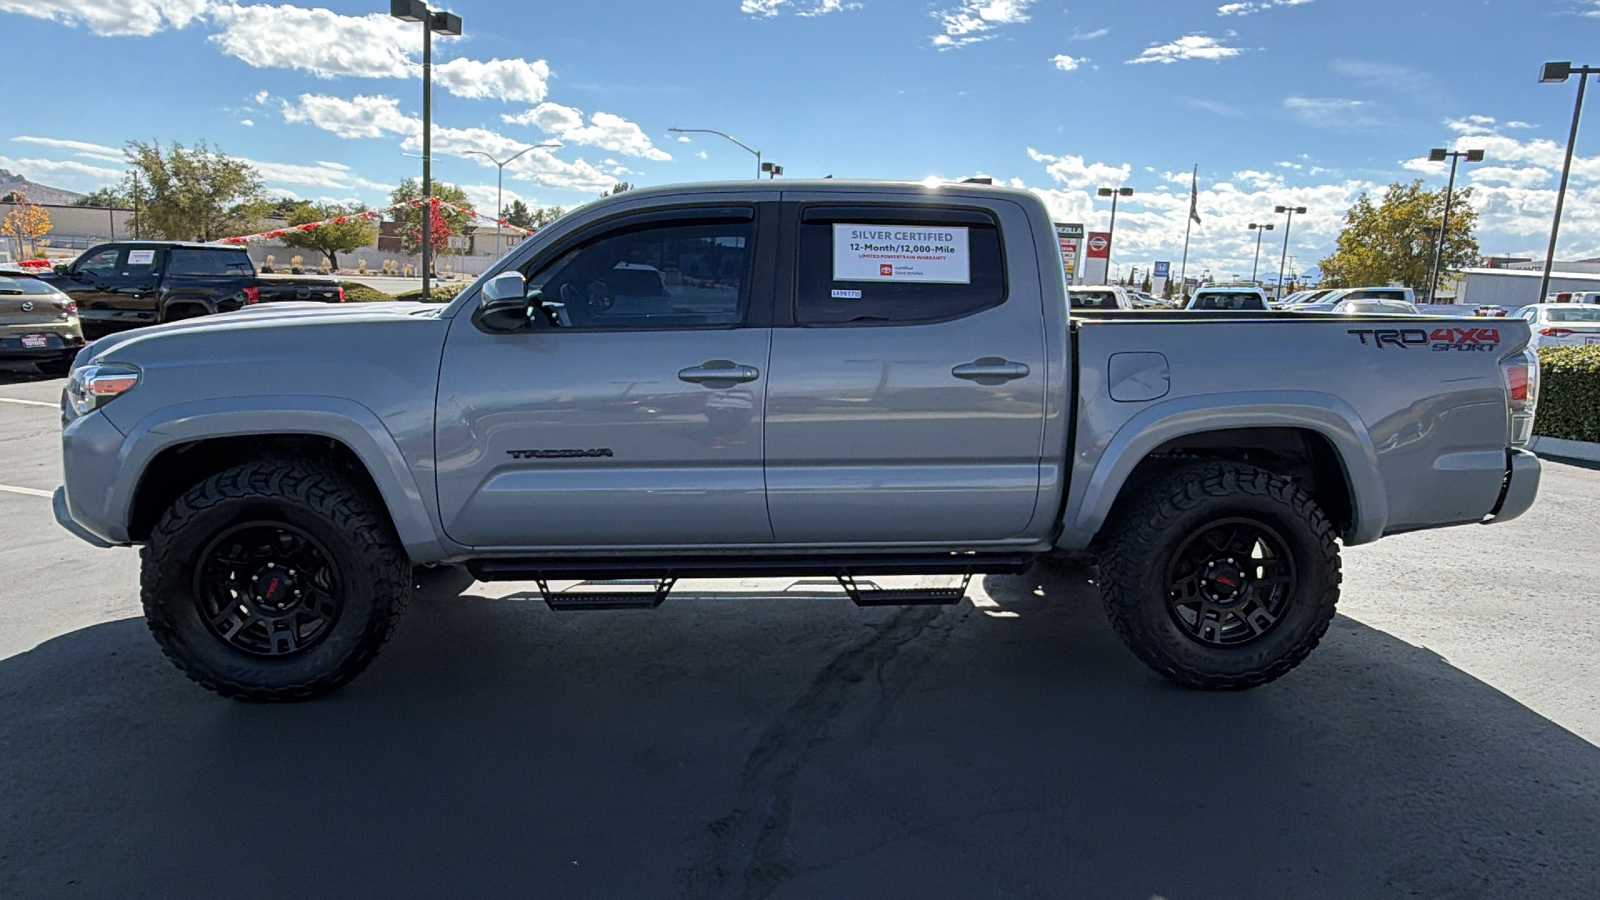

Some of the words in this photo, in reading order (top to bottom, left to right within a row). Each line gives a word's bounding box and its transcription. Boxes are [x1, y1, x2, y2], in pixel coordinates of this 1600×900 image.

[851, 230, 892, 240] SILVER
[894, 231, 953, 242] CERTIFIED
[850, 243, 955, 253] 12-Month/12,000-Mile
[1347, 329, 1430, 349] TRD
[1432, 343, 1499, 352] SPORT
[506, 448, 613, 458] TACOMA
